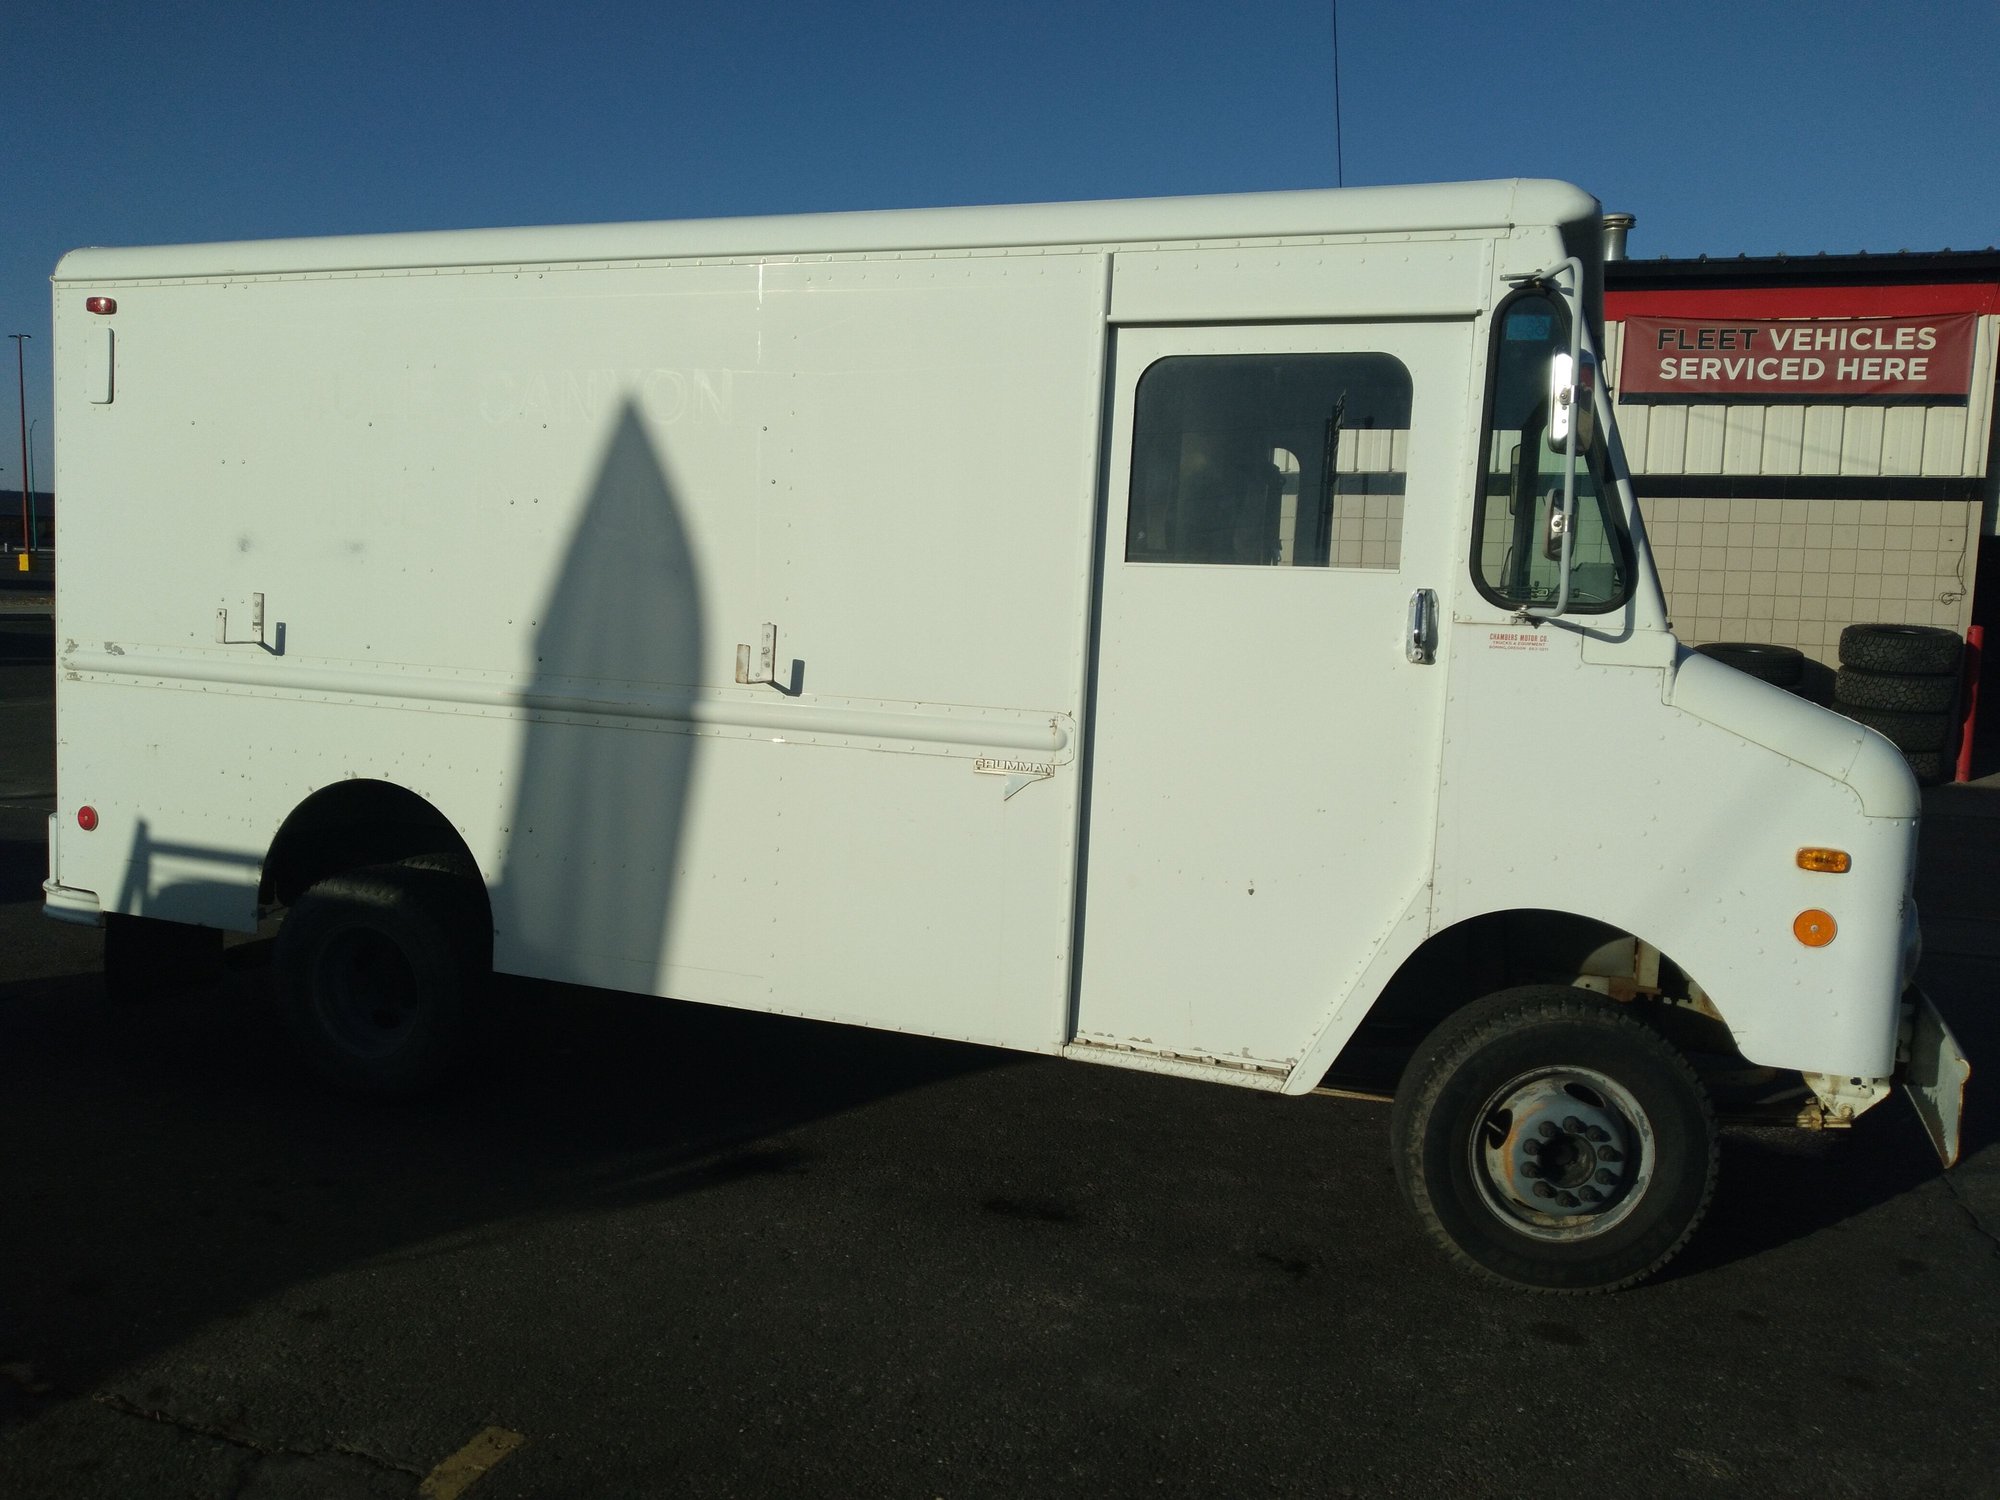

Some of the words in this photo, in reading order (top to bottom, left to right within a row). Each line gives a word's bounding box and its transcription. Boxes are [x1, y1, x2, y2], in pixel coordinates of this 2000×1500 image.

[1657, 328, 1759, 350] FLEET
[1769, 327, 1937, 350] VEHICLES
[1659, 357, 1825, 381] SERVICED
[1837, 357, 1929, 381] HERE
[975, 759, 1055, 774] GRUMMAN
